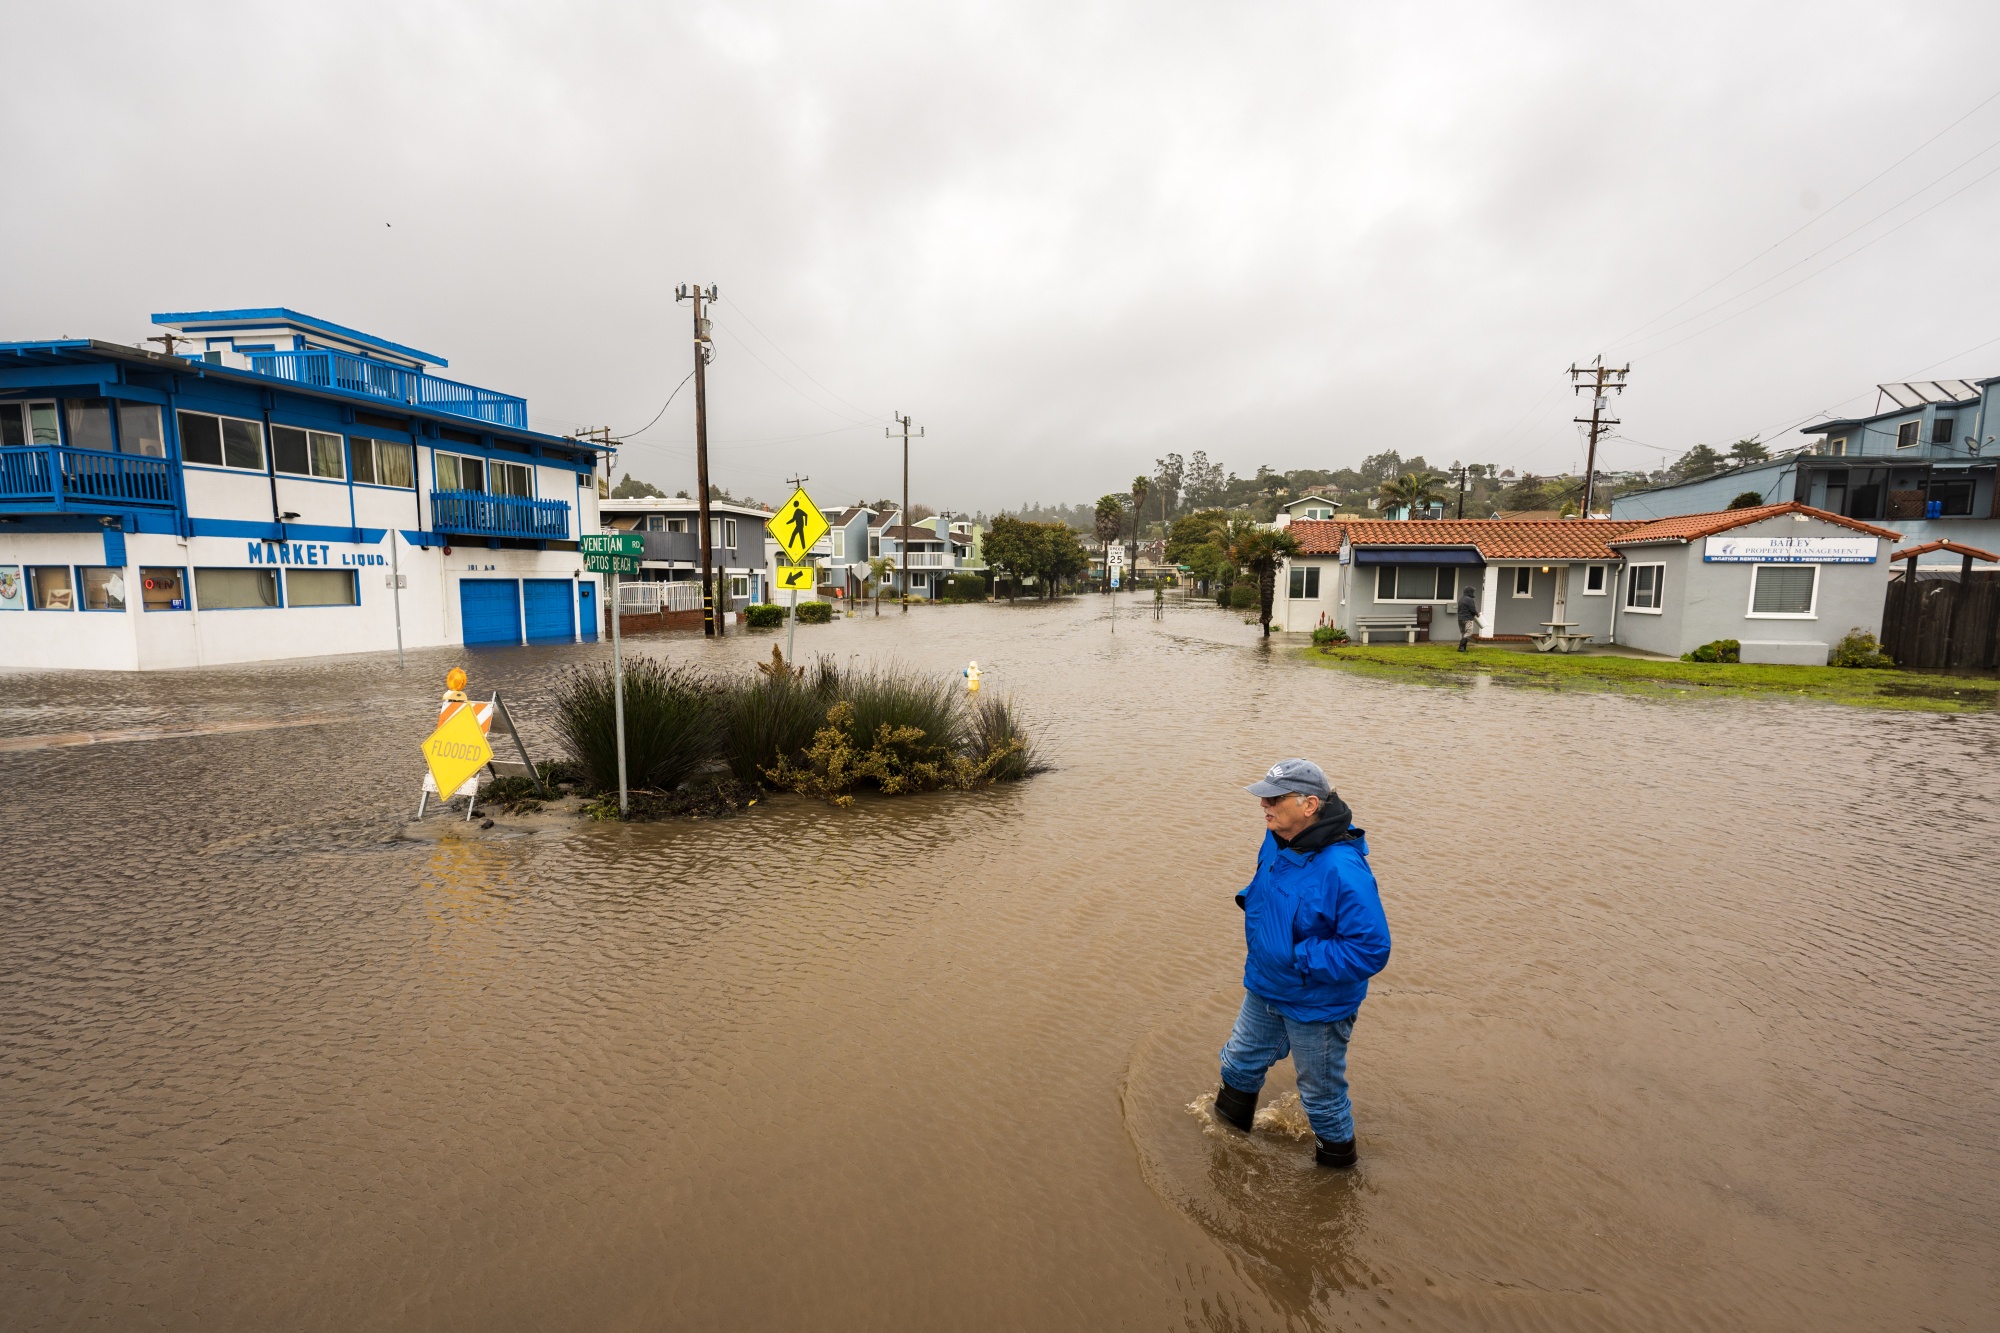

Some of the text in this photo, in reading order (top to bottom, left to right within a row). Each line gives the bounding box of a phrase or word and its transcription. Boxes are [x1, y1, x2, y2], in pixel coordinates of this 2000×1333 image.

[583, 537, 640, 552] VENETIAN RD
[248, 542, 389, 566] MARKET LIQUO
[1110, 555, 1122, 564] 25
[586, 555, 609, 570] APTOS
[612, 556, 631, 571] BEACH
[431, 740, 482, 762] FLOODED
